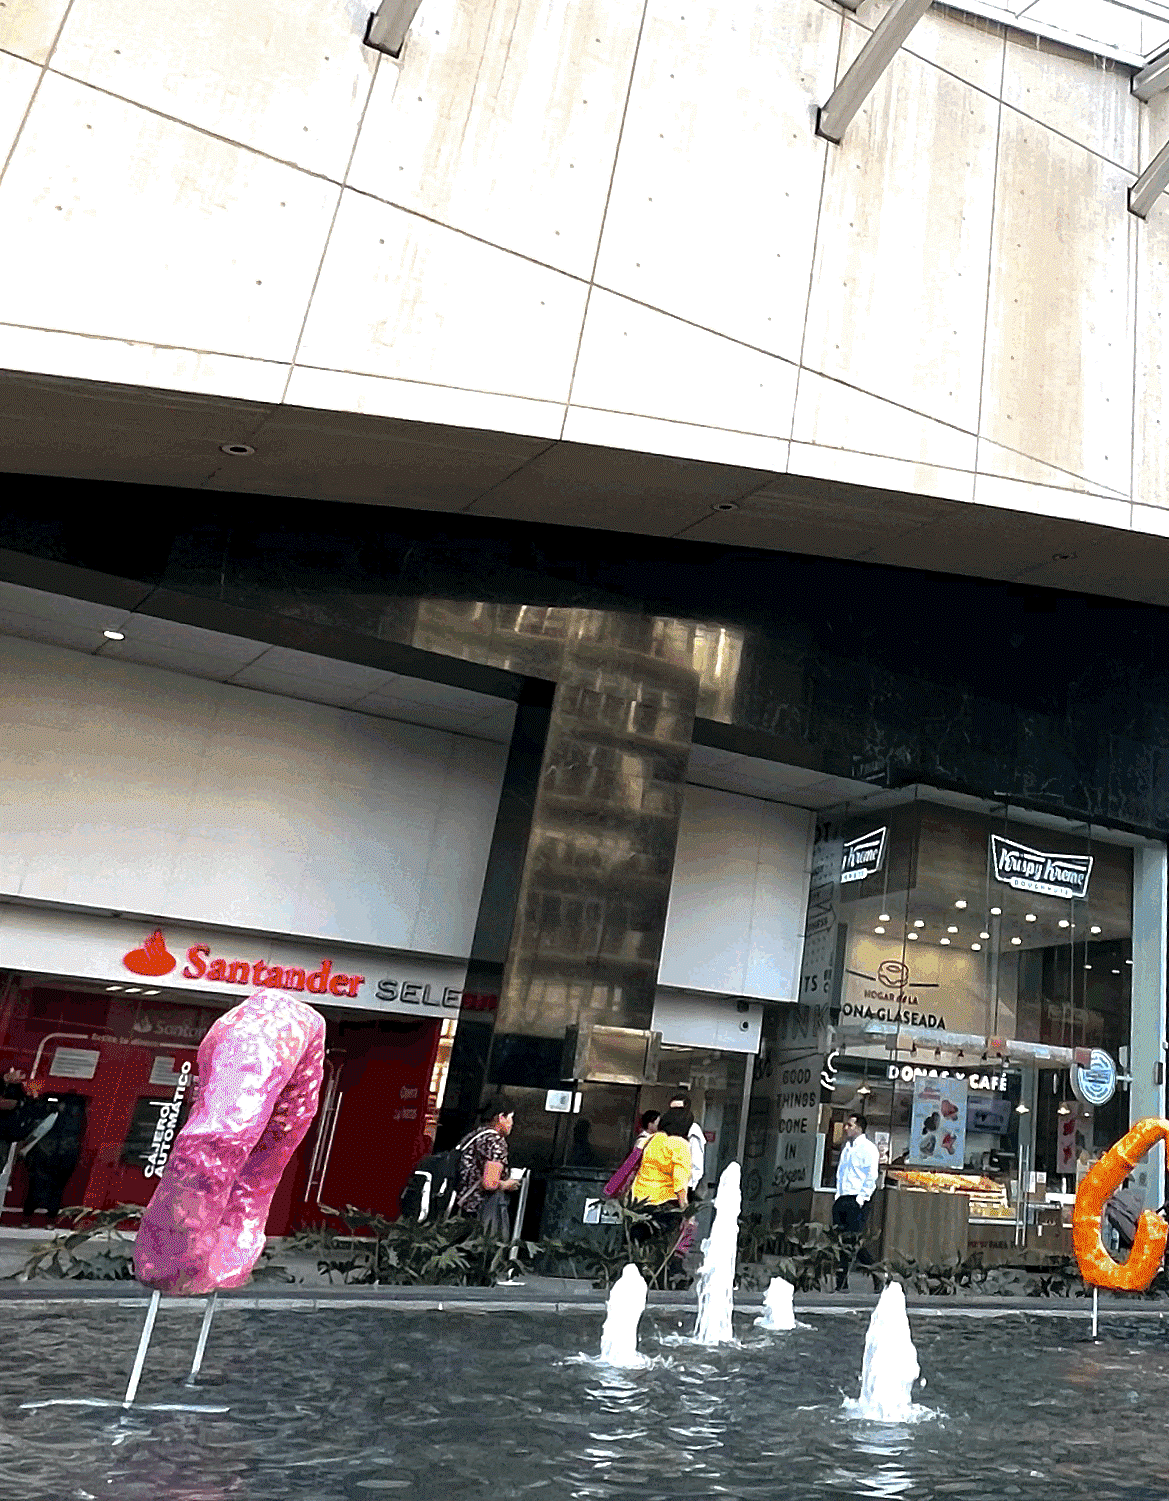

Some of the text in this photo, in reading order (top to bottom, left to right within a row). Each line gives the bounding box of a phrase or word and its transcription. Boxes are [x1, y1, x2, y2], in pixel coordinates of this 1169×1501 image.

[998, 847, 1087, 886] Krispy Kreme
[184, 943, 365, 997] Santander
[864, 989, 895, 1002] HOGAR
[842, 1002, 946, 1031] ONA GLASEADA
[781, 1068, 811, 1085] GOOD
[968, 1072, 1008, 1092] CAFÉ
[776, 1091, 816, 1108] THINGS
[778, 1117, 808, 1134] COME
[144, 1105, 171, 1178] CAJERO
[784, 1140, 797, 1160] IN
